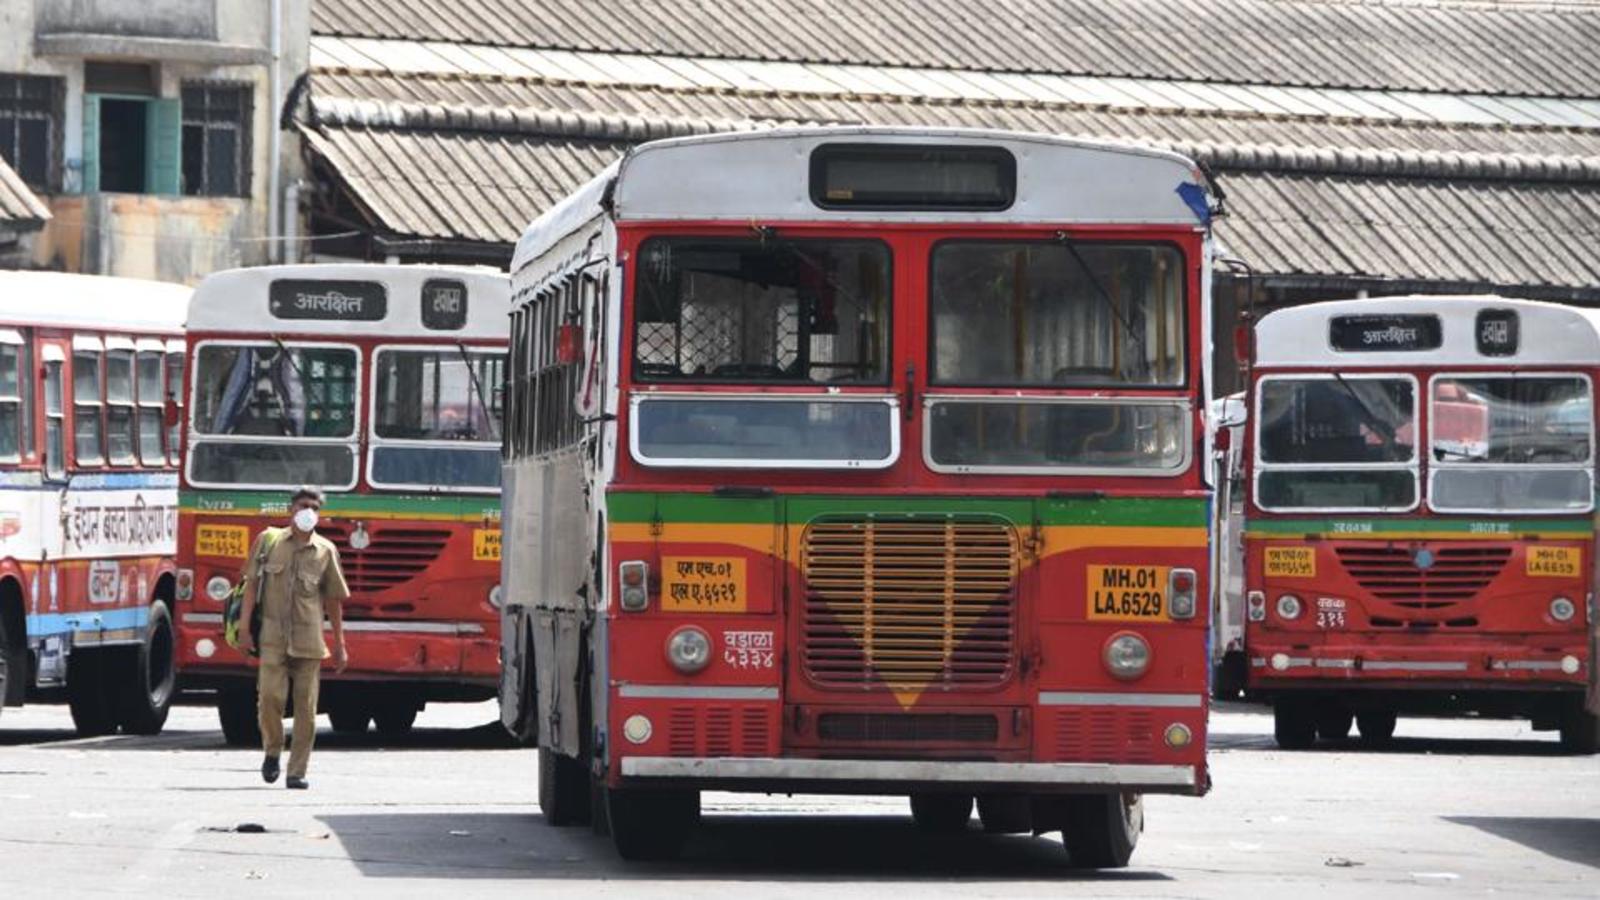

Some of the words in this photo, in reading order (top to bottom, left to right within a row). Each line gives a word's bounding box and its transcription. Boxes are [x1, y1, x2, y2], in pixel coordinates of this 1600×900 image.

[294, 290, 363, 314] आरक्षित
[1362, 326, 1417, 345] आरक्षित
[677, 561, 694, 578] एम
[1102, 568, 1157, 589] MH.01
[1094, 591, 1162, 616] LA.6529
[723, 630, 774, 649] वडाळा
[723, 650, 775, 669] ५३३४
